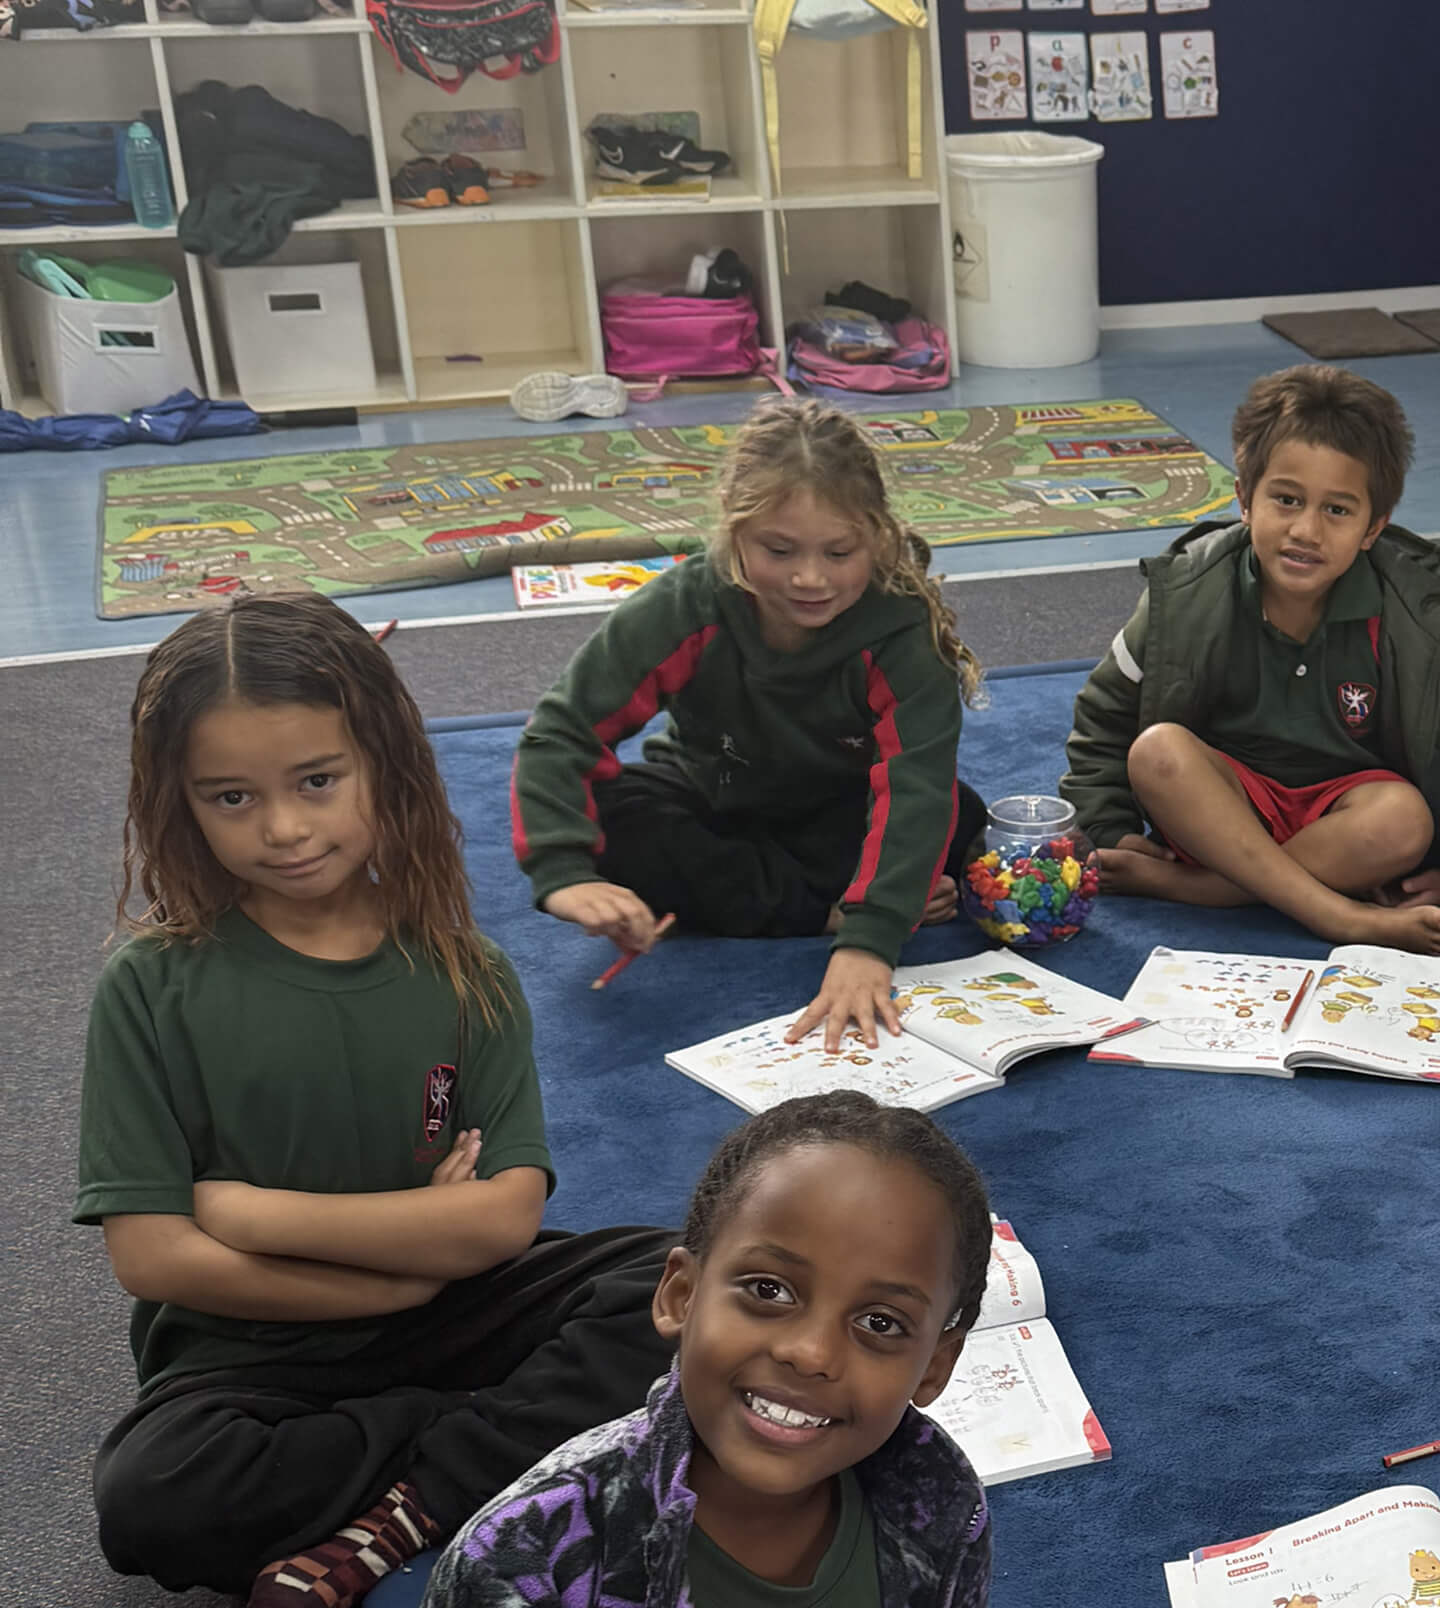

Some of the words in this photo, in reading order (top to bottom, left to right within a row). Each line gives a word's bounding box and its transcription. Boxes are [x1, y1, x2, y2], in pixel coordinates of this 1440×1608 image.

[1292, 1525, 1342, 1547] Breaking
[1344, 1510, 1375, 1527] Apart
[1377, 1502, 1400, 1514] and
[1226, 1550, 1265, 1566] Lesson
